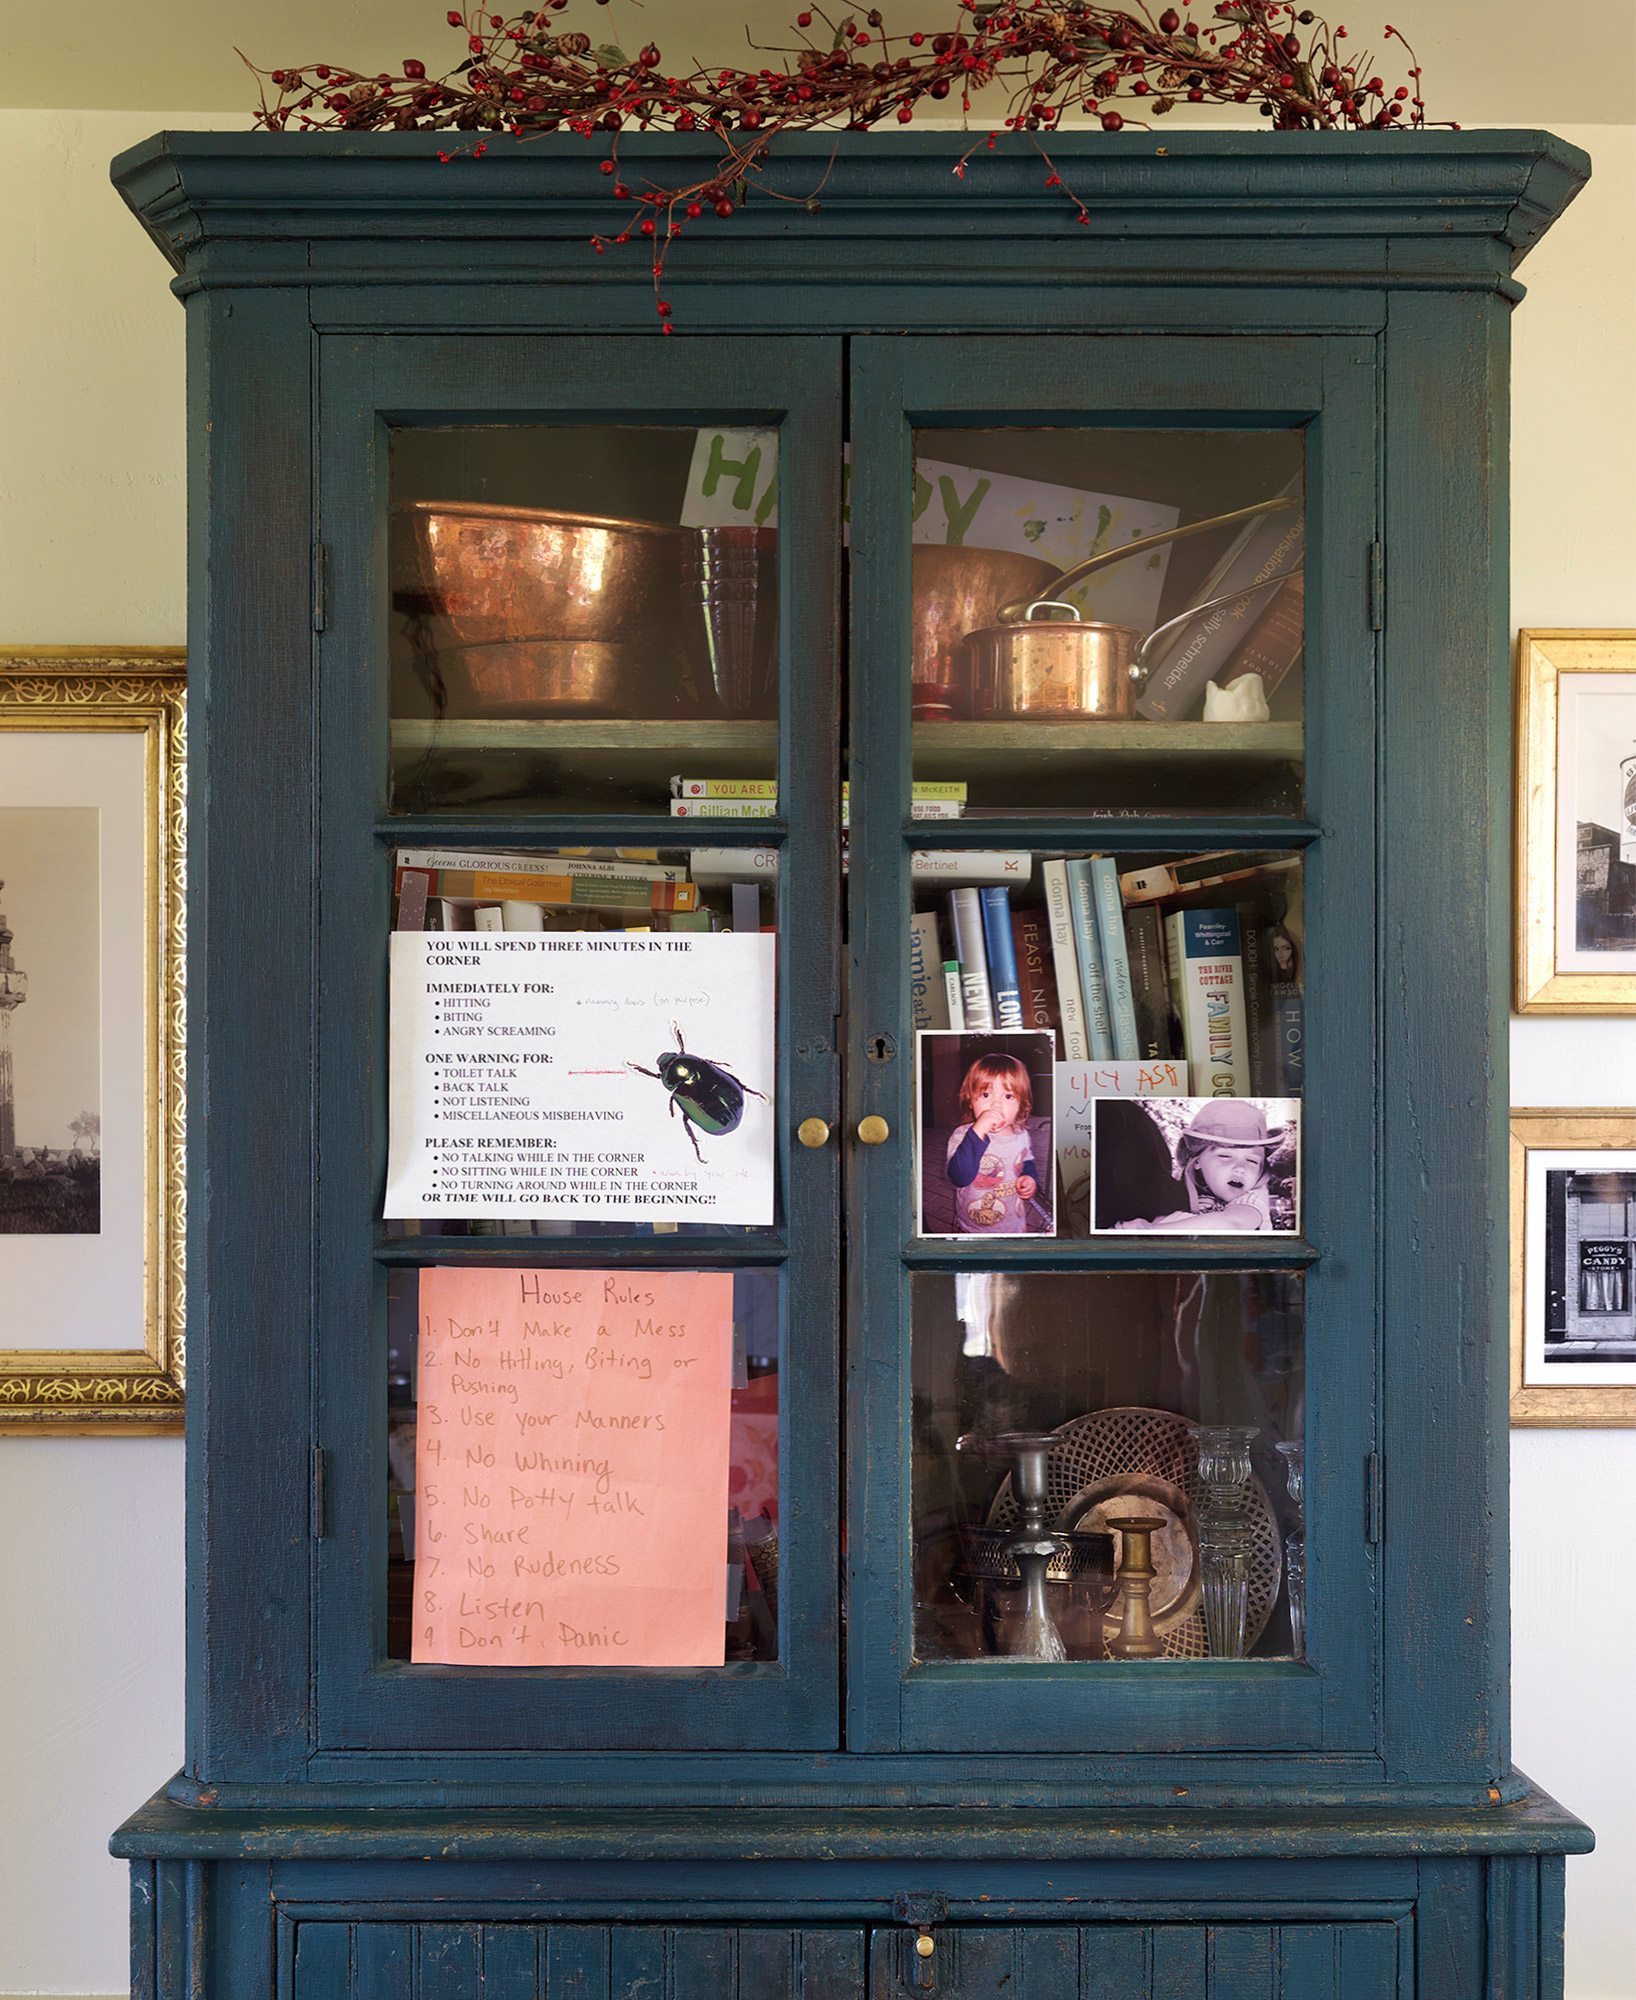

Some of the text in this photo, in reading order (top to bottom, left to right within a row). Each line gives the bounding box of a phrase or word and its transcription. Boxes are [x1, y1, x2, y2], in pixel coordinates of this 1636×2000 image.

[1163, 606, 1227, 691] sally schneider
[713, 784, 737, 794] YOU
[741, 784, 764, 794] ARE
[699, 804, 738, 817] Gillian
[459, 859, 511, 871] GLORIOUS
[511, 863, 549, 873] GREENS!
[567, 862, 597, 871] JOHNNA
[915, 859, 959, 871] Bertinet
[1005, 860, 1019, 872] K
[482, 875, 562, 889] The Ethical Gourmet
[1103, 874, 1116, 912] donna
[1107, 914, 1119, 937] hay
[427, 940, 692, 952] YOU WILL SPEND THREE MINUTES IN THE
[1023, 923, 1044, 974] FEAST
[426, 955, 480, 966] CORNER
[1078, 879, 1108, 1036] donna hay off the shelf
[1051, 877, 1083, 1060] donna hay new food
[1198, 964, 1233, 975] THE RIVER
[1199, 974, 1234, 986] COTTAGE
[427, 983, 554, 994] IMMEDIATELY FOR:
[949, 977, 957, 1006] CARLSON
[963, 971, 989, 1011] NEW
[444, 998, 490, 1008] HITTING
[997, 990, 1023, 1030] LON
[1246, 929, 1263, 1086] DOUGH: Simple Contemporary Bread
[444, 1012, 482, 1022] BITING
[443, 1026, 555, 1036] ANGRY SCREAMING
[1117, 1005, 1135, 1060] classics
[1206, 990, 1234, 1066] FAMILY
[1286, 1010, 1303, 1068] HOW
[425, 1053, 552, 1064] ONE WARNING FOR:
[443, 1068, 517, 1078] TOILET TALK
[443, 1082, 508, 1093] BACK TALK
[443, 1096, 529, 1107] NOT LISTENING
[443, 1110, 623, 1121] MISCELLANEOUS MISBEHAVING
[425, 1137, 556, 1149] PLEASE REMEMBER:
[442, 1152, 644, 1163] NO TALKING WHILE IN THE CORNER
[442, 1166, 638, 1177] NO SITTING WHILE IN THE CORNER
[441, 1180, 697, 1191] NO TURNING AROUND WHILE IN THE CORNER
[422, 1192, 716, 1205] OR TIME WILL GO BACK TO THE BEGINNING!!
[1583, 1257, 1627, 1266] CANDY
[520, 1274, 655, 1306] House Rules
[425, 1315, 437, 1335] 1.
[522, 1321, 572, 1340] Make
[597, 1325, 612, 1337] a
[634, 1318, 687, 1338] Mess
[424, 1346, 698, 1380] 2. No Hitting, Biting or
[450, 1373, 519, 1405] Pushing
[425, 1404, 667, 1436] 3. Use your Manners
[426, 1438, 615, 1495] 4. No Whining
[424, 1484, 446, 1508] 5.
[462, 1485, 491, 1510] No
[509, 1485, 575, 1521] Potty
[427, 1519, 530, 1546] 6. Share
[425, 1550, 621, 1579] 7. No Rudeness
[424, 1590, 546, 1623] 8. Listen
[557, 1621, 630, 1649] Panic
